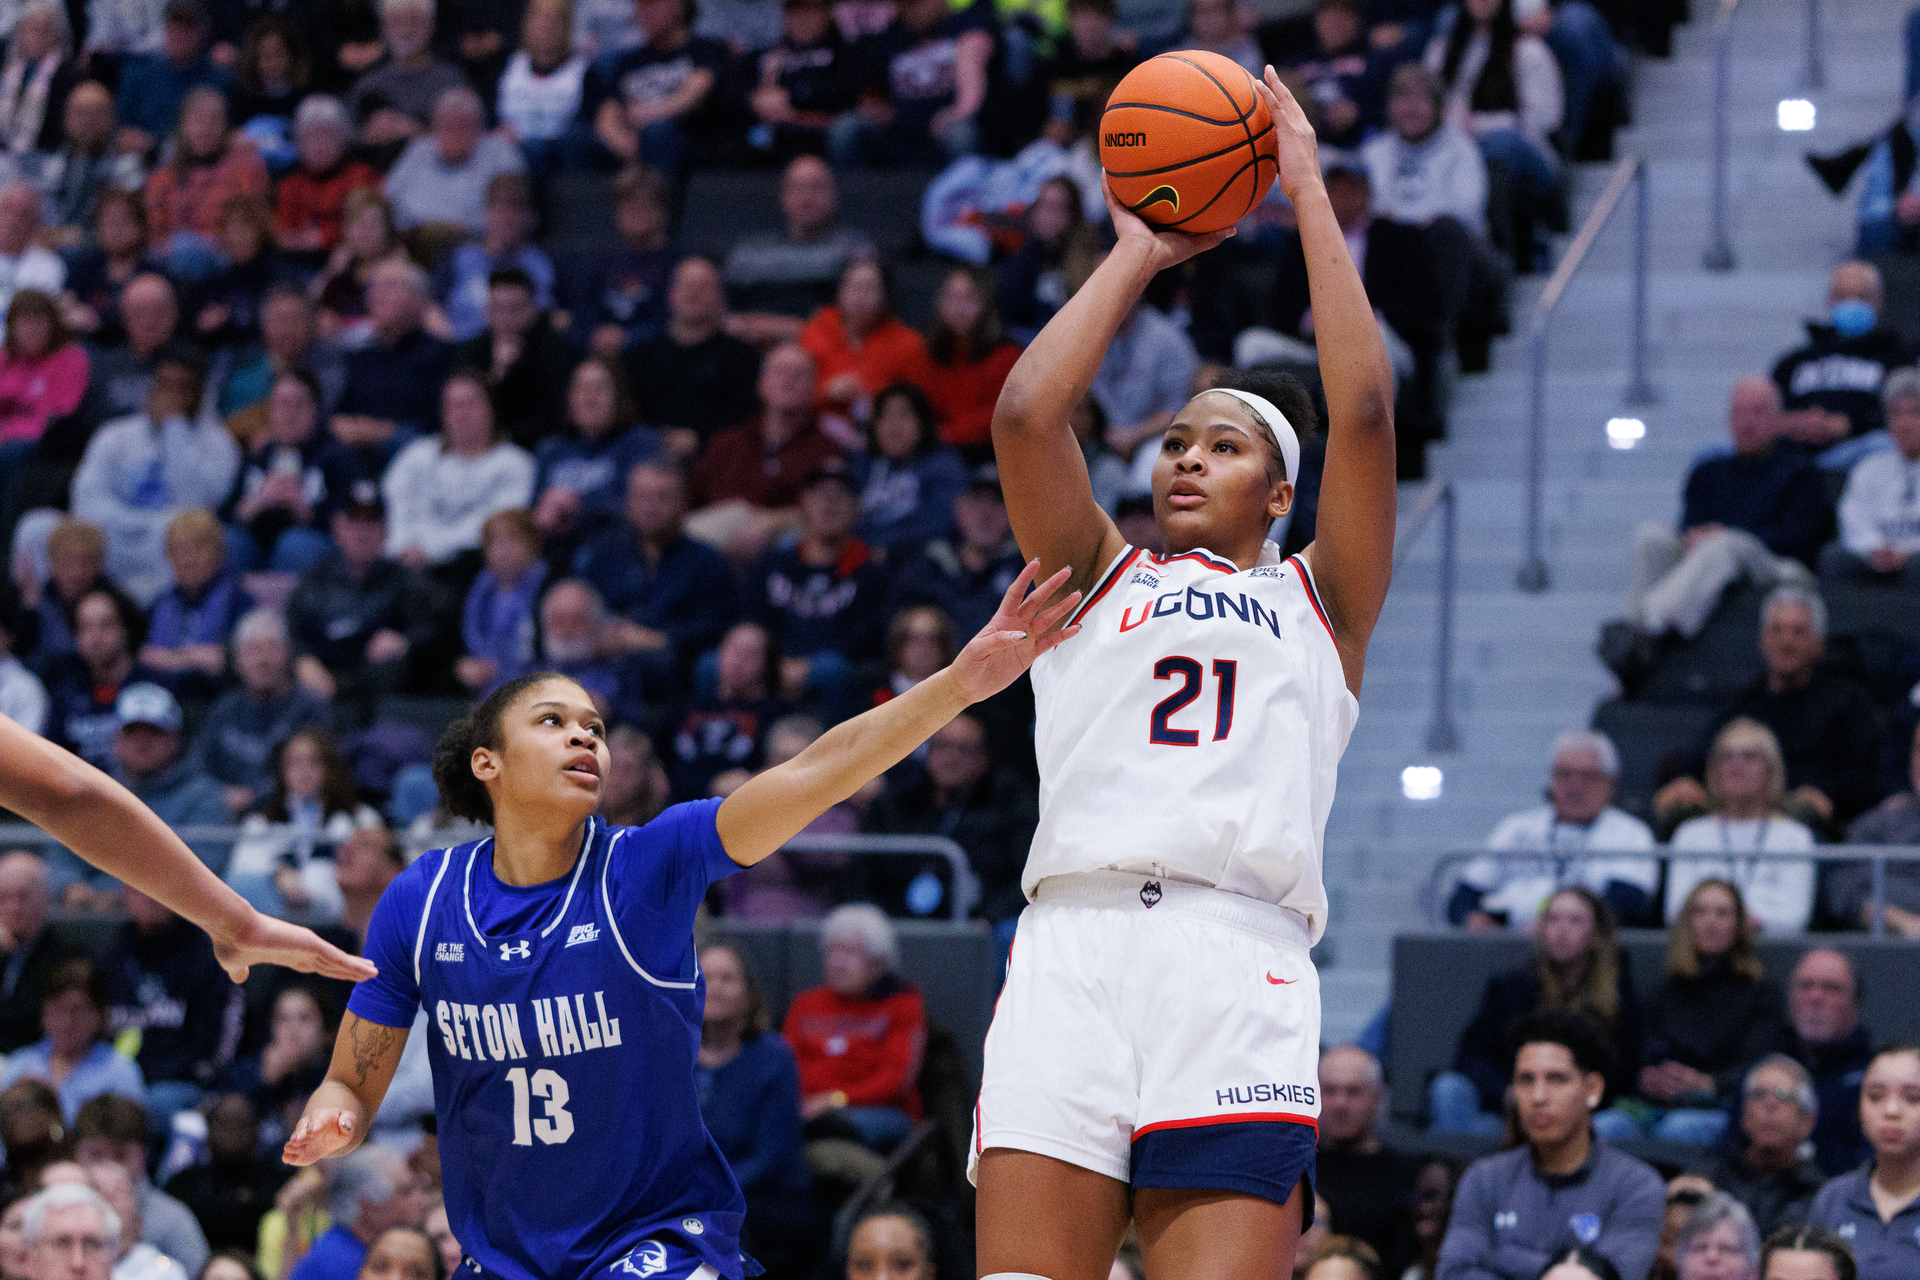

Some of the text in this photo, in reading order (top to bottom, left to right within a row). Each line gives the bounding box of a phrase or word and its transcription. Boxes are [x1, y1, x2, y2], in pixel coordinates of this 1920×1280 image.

[1104, 132, 1146, 147] UCONN
[1144, 573, 1161, 585] THE
[1119, 586, 1281, 640] UCONN
[1149, 655, 1237, 747] 21
[566, 928, 601, 943] EAST
[571, 922, 595, 935] BIG
[437, 942, 464, 952] BE THE
[434, 951, 465, 962] CHANGE
[436, 990, 622, 1061] SETON HALL
[1215, 1083, 1315, 1106] HUSKIES
[504, 1067, 575, 1146] 13
